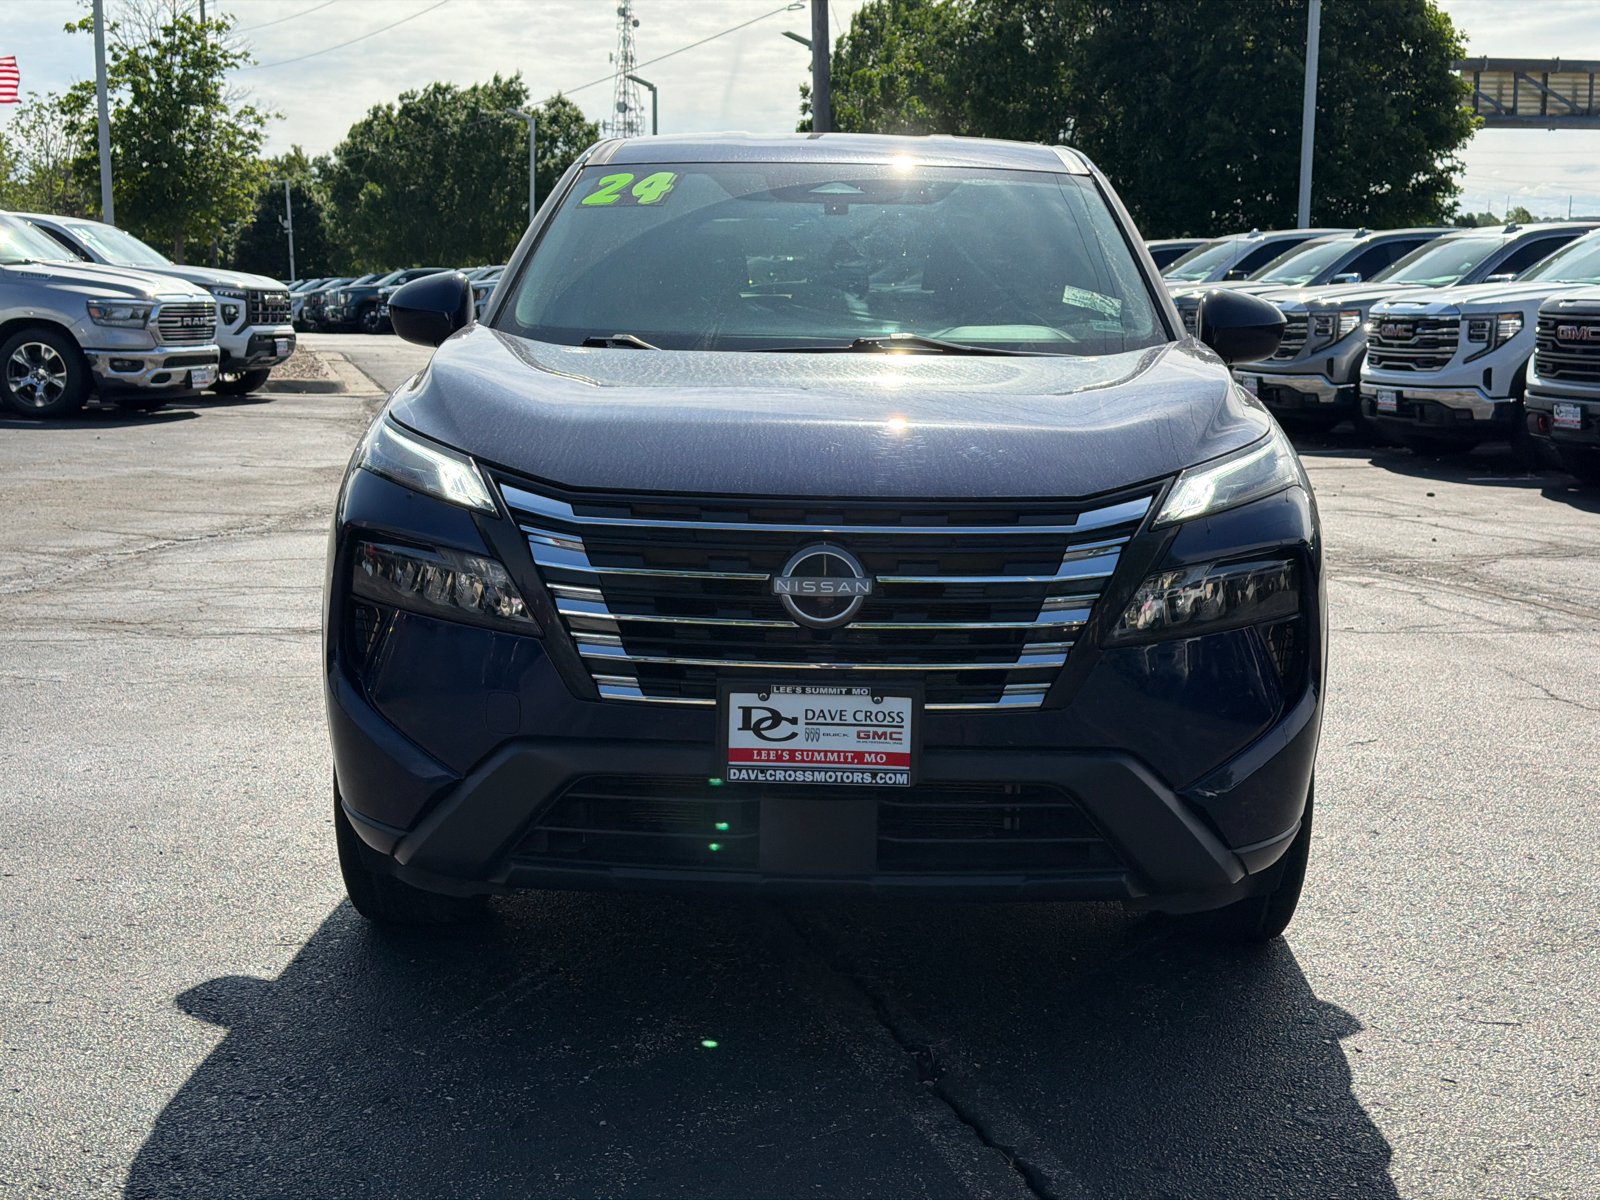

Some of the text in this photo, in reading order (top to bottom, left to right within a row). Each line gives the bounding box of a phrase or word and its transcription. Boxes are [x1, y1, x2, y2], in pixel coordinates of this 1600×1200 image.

[582, 172, 677, 205] 24
[1381, 323, 1413, 337] GMC
[1557, 325, 1600, 341] GMC
[776, 580, 869, 593] NISSAN
[773, 686, 869, 696] LEE'S SUMMIT MO
[804, 708, 905, 724] DAVE CROSS
[737, 706, 799, 742] DC
[856, 730, 903, 742] GMC
[795, 751, 858, 764] SUMMIT,
[863, 753, 887, 763] MO
